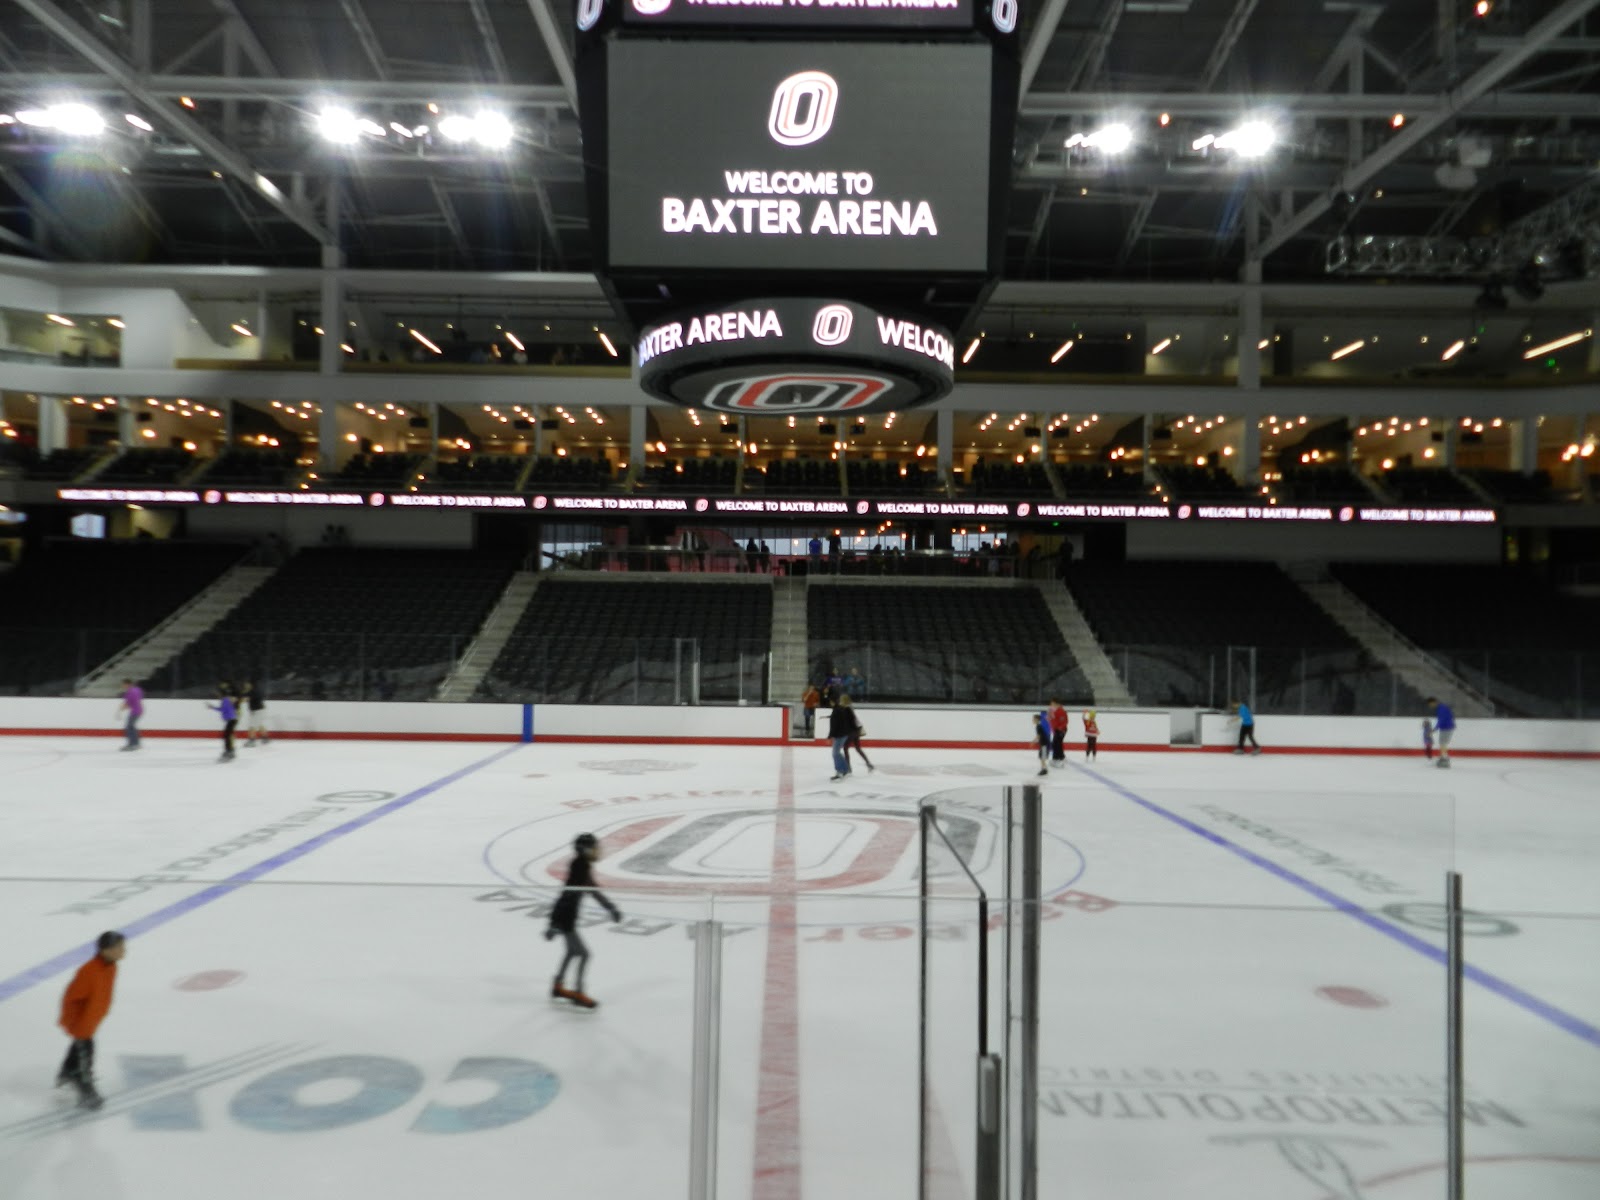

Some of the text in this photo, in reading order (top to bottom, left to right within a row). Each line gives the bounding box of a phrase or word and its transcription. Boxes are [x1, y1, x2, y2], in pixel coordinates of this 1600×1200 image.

[725, 170, 873, 195] WELCOME TO
[662, 199, 938, 236] BAXTER ARENA
[638, 321, 684, 368] AXTER
[686, 309, 783, 346] ARENA
[877, 316, 954, 370] WELCOM
[553, 498, 602, 508] WELCOME
[604, 498, 617, 509] TO
[618, 499, 654, 509] BAXTER
[715, 500, 763, 511] WELCOME
[765, 500, 778, 512] TO
[779, 502, 814, 512] BAXTER
[816, 503, 848, 512] ARENA
[877, 503, 924, 513] WELCOME
[926, 503, 938, 514] TO
[940, 504, 975, 514] BAXTER
[976, 505, 1009, 515] ARENA
[1037, 505, 1085, 516] WELCOME
[1087, 505, 1100, 516] TO
[1101, 506, 1136, 516] BAXTER
[1137, 507, 1170, 517] ARENA
[1198, 508, 1247, 518] WELCOME
[1248, 508, 1261, 518] TO
[1036, 1066, 1468, 1090] TILITIES DISTRIC
